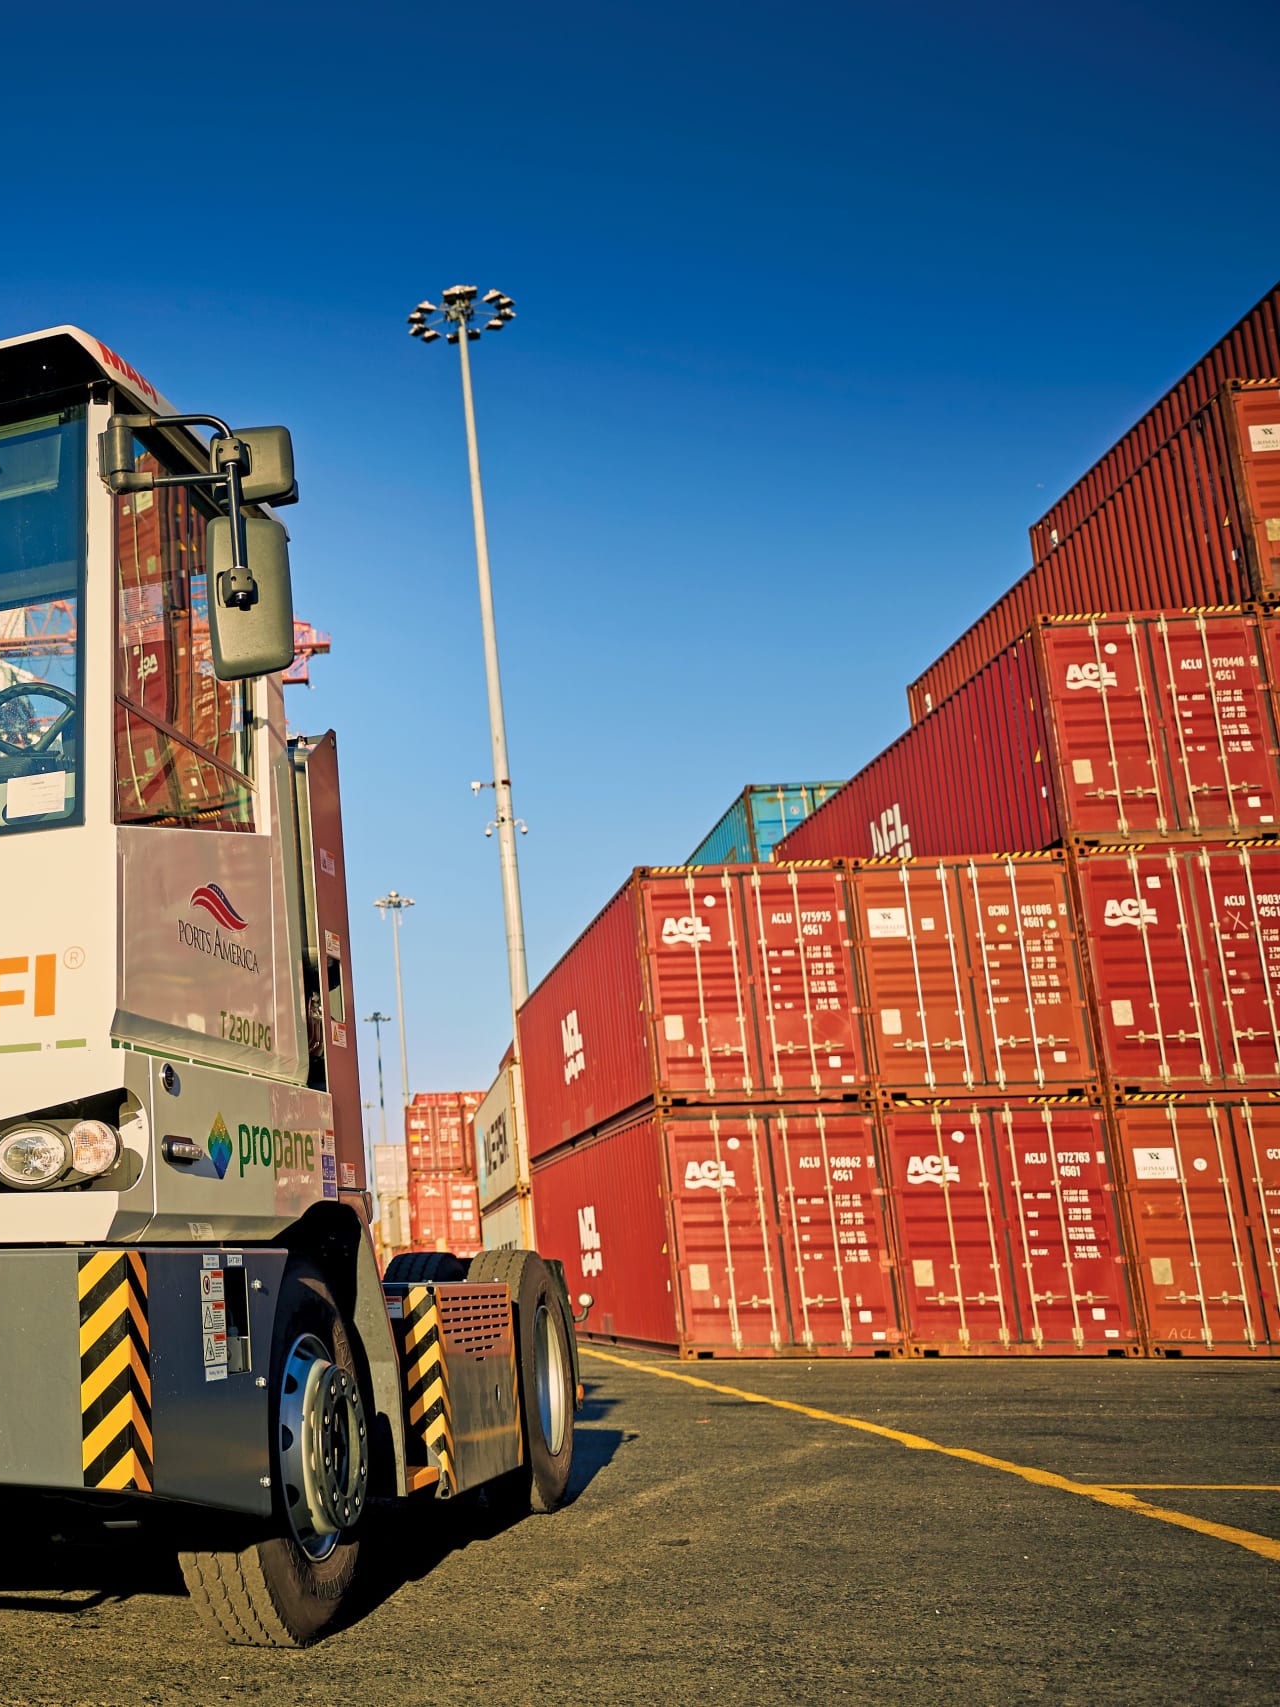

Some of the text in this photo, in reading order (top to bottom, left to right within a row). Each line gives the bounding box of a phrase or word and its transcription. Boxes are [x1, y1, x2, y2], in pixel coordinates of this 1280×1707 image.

[96, 340, 158, 405] MAFI
[1066, 661, 1116, 680] ACL
[1181, 658, 1202, 670] ACLU
[1215, 670, 1236, 680] 45G1
[1104, 898, 1157, 917] ACL
[1224, 895, 1246, 906] ACLU
[772, 910, 832, 924] ACLU 975935
[1024, 916, 1044, 928] 45G1
[662, 916, 711, 936] ACL
[802, 924, 823, 936] 45G1
[178, 919, 212, 954] PORTS
[220, 1010, 272, 1052] T 230 LPG
[238, 1123, 315, 1181] propane
[1024, 1152, 1047, 1164] ACLU
[1057, 1152, 1090, 1164] 972763
[799, 1156, 820, 1168] ACLU
[830, 1156, 862, 1168] 968862
[907, 1155, 959, 1174] ACL
[685, 1160, 735, 1179] ACL
[832, 1169, 853, 1182] 45G1
[1168, 1327, 1197, 1340] ACL
